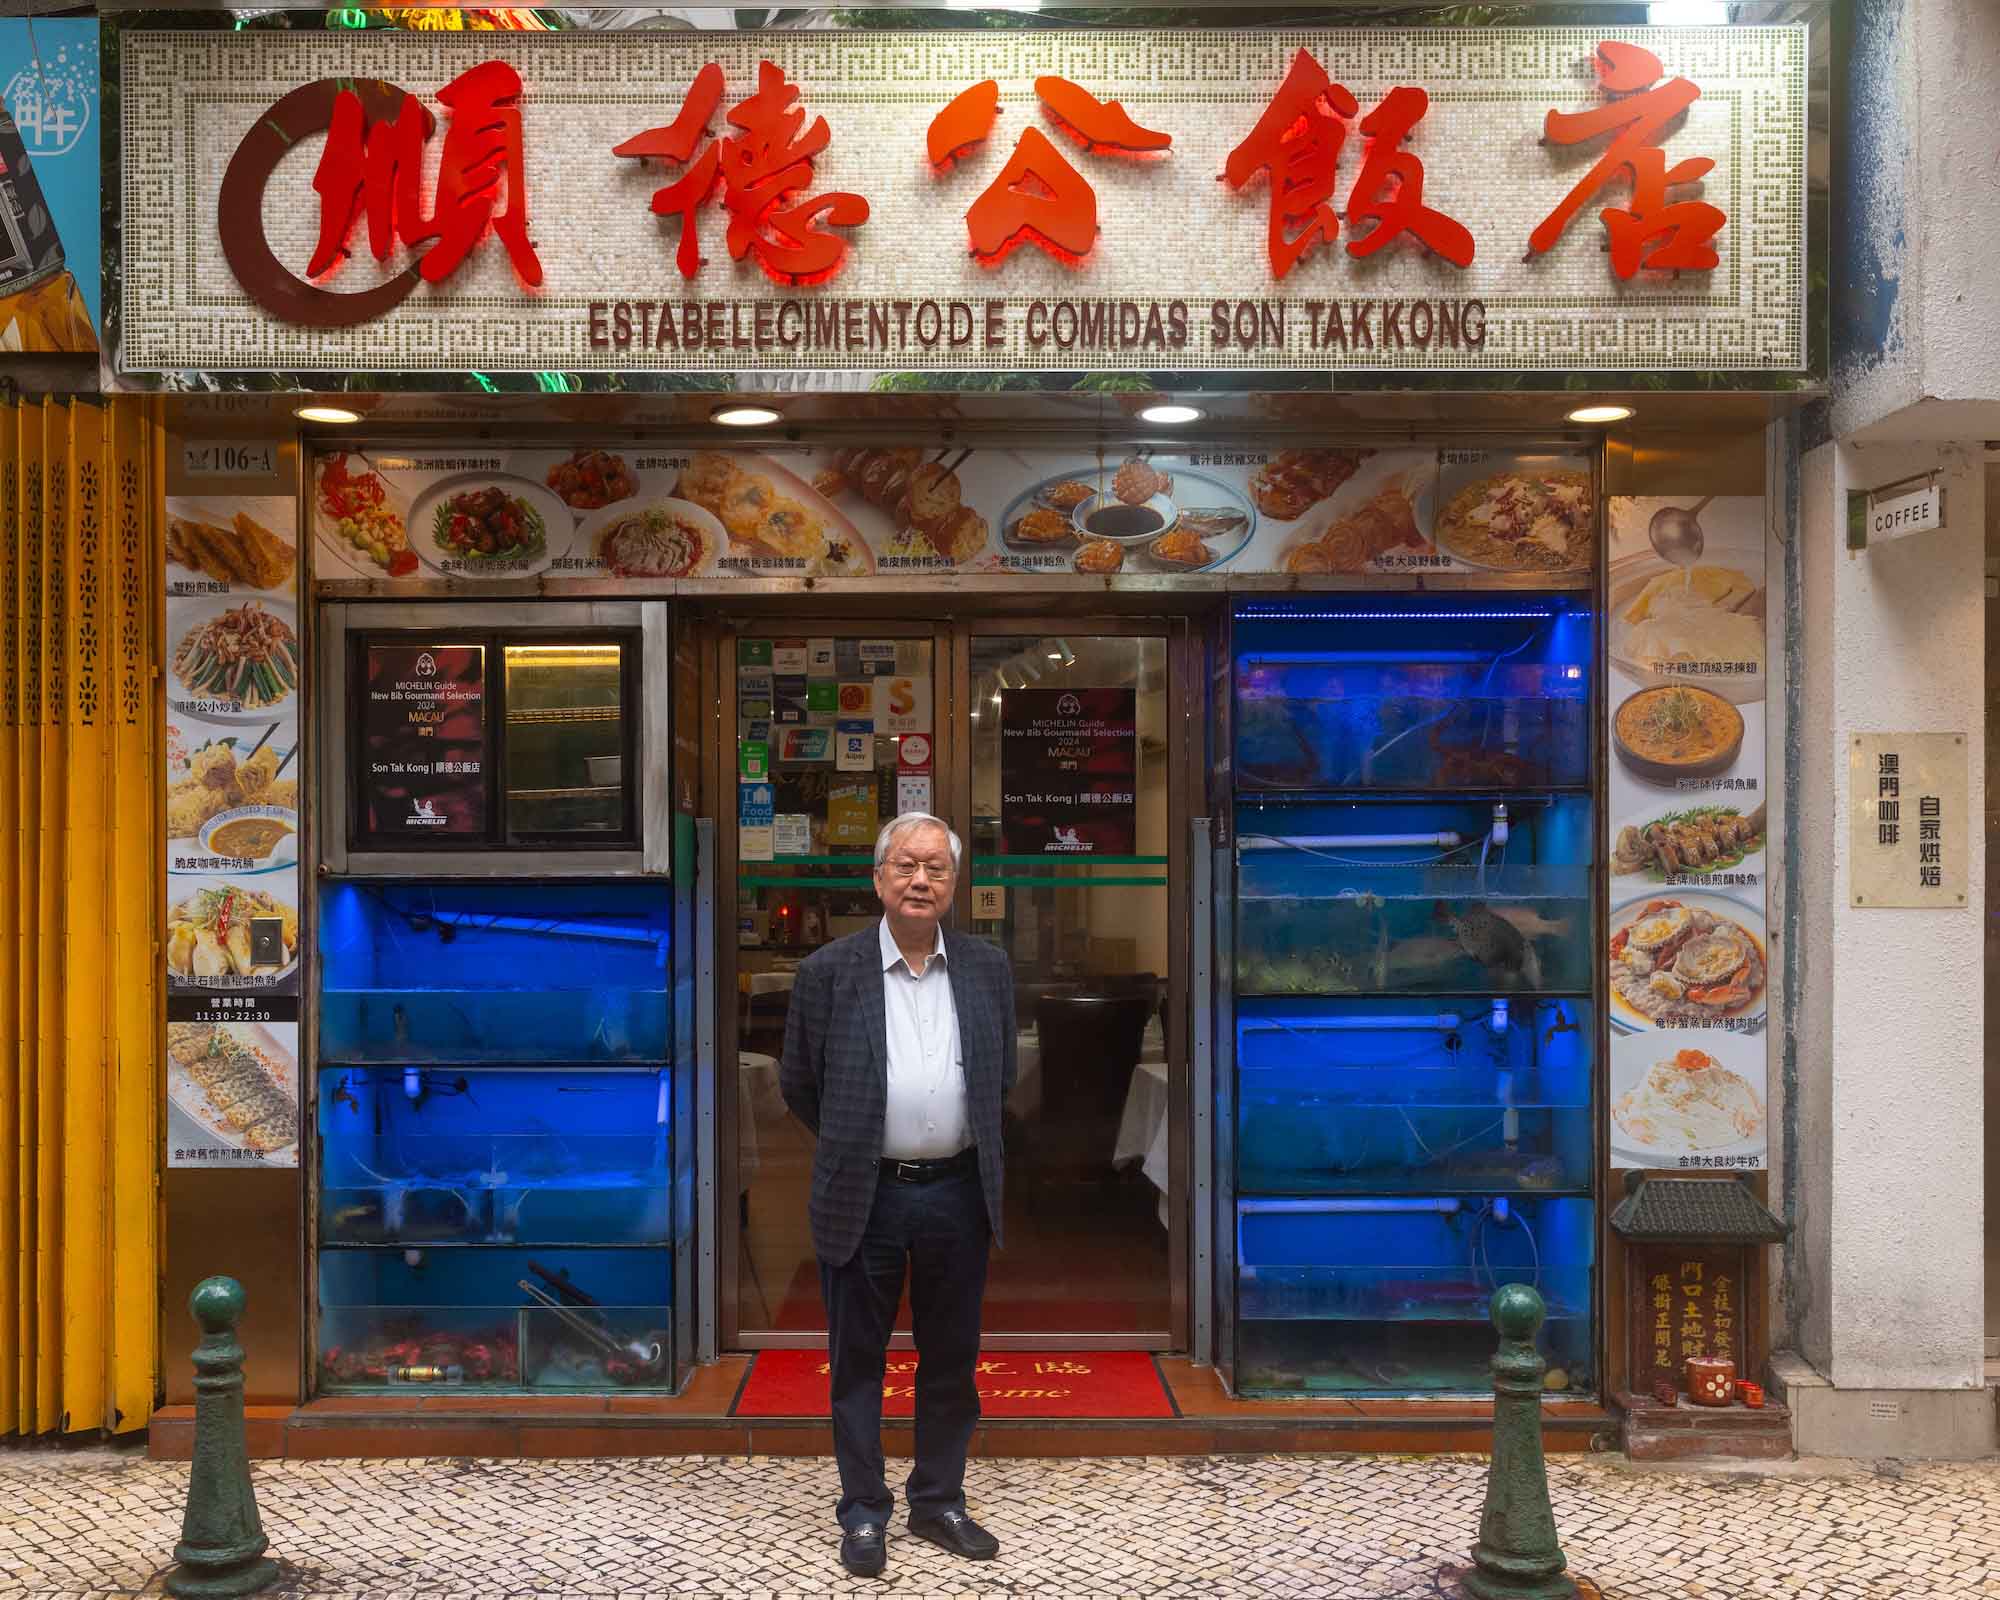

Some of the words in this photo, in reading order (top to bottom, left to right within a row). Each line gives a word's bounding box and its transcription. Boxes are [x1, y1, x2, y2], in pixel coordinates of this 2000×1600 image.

[307, 40, 1727, 287] 順德公飯店
[1025, 302, 1188, 351] COMIDAS
[1211, 302, 1286, 351] SON
[1875, 502, 1929, 532] COFFEE
[396, 682, 432, 690] MICHELIN
[434, 682, 457, 690] Guide
[371, 691, 389, 700] New
[391, 691, 404, 700] Bib
[405, 691, 445, 700] Gourmand
[447, 691, 481, 700] Selection
[417, 701, 435, 710] 2024
[408, 711, 445, 722] MACAU
[1032, 720, 1076, 728] MICHELIN
[1078, 720, 1104, 728] Guide
[1003, 728, 1024, 737] New
[1027, 728, 1041, 737] Bib
[1044, 728, 1091, 737] Gourmand
[1094, 728, 1134, 737] Selection
[372, 762, 388, 773] Son
[390, 762, 404, 773] Tak
[406, 762, 429, 775] Kong
[1004, 793, 1023, 803] Son
[1025, 793, 1042, 803] Tak
[1045, 793, 1072, 805] Kong
[1878, 753, 1900, 845] 澳門咖啡
[1919, 795, 1941, 887] 自家烘焙
[211, 998, 256, 1008] 營業時間
[195, 1011, 271, 1021] 11:30-22:30
